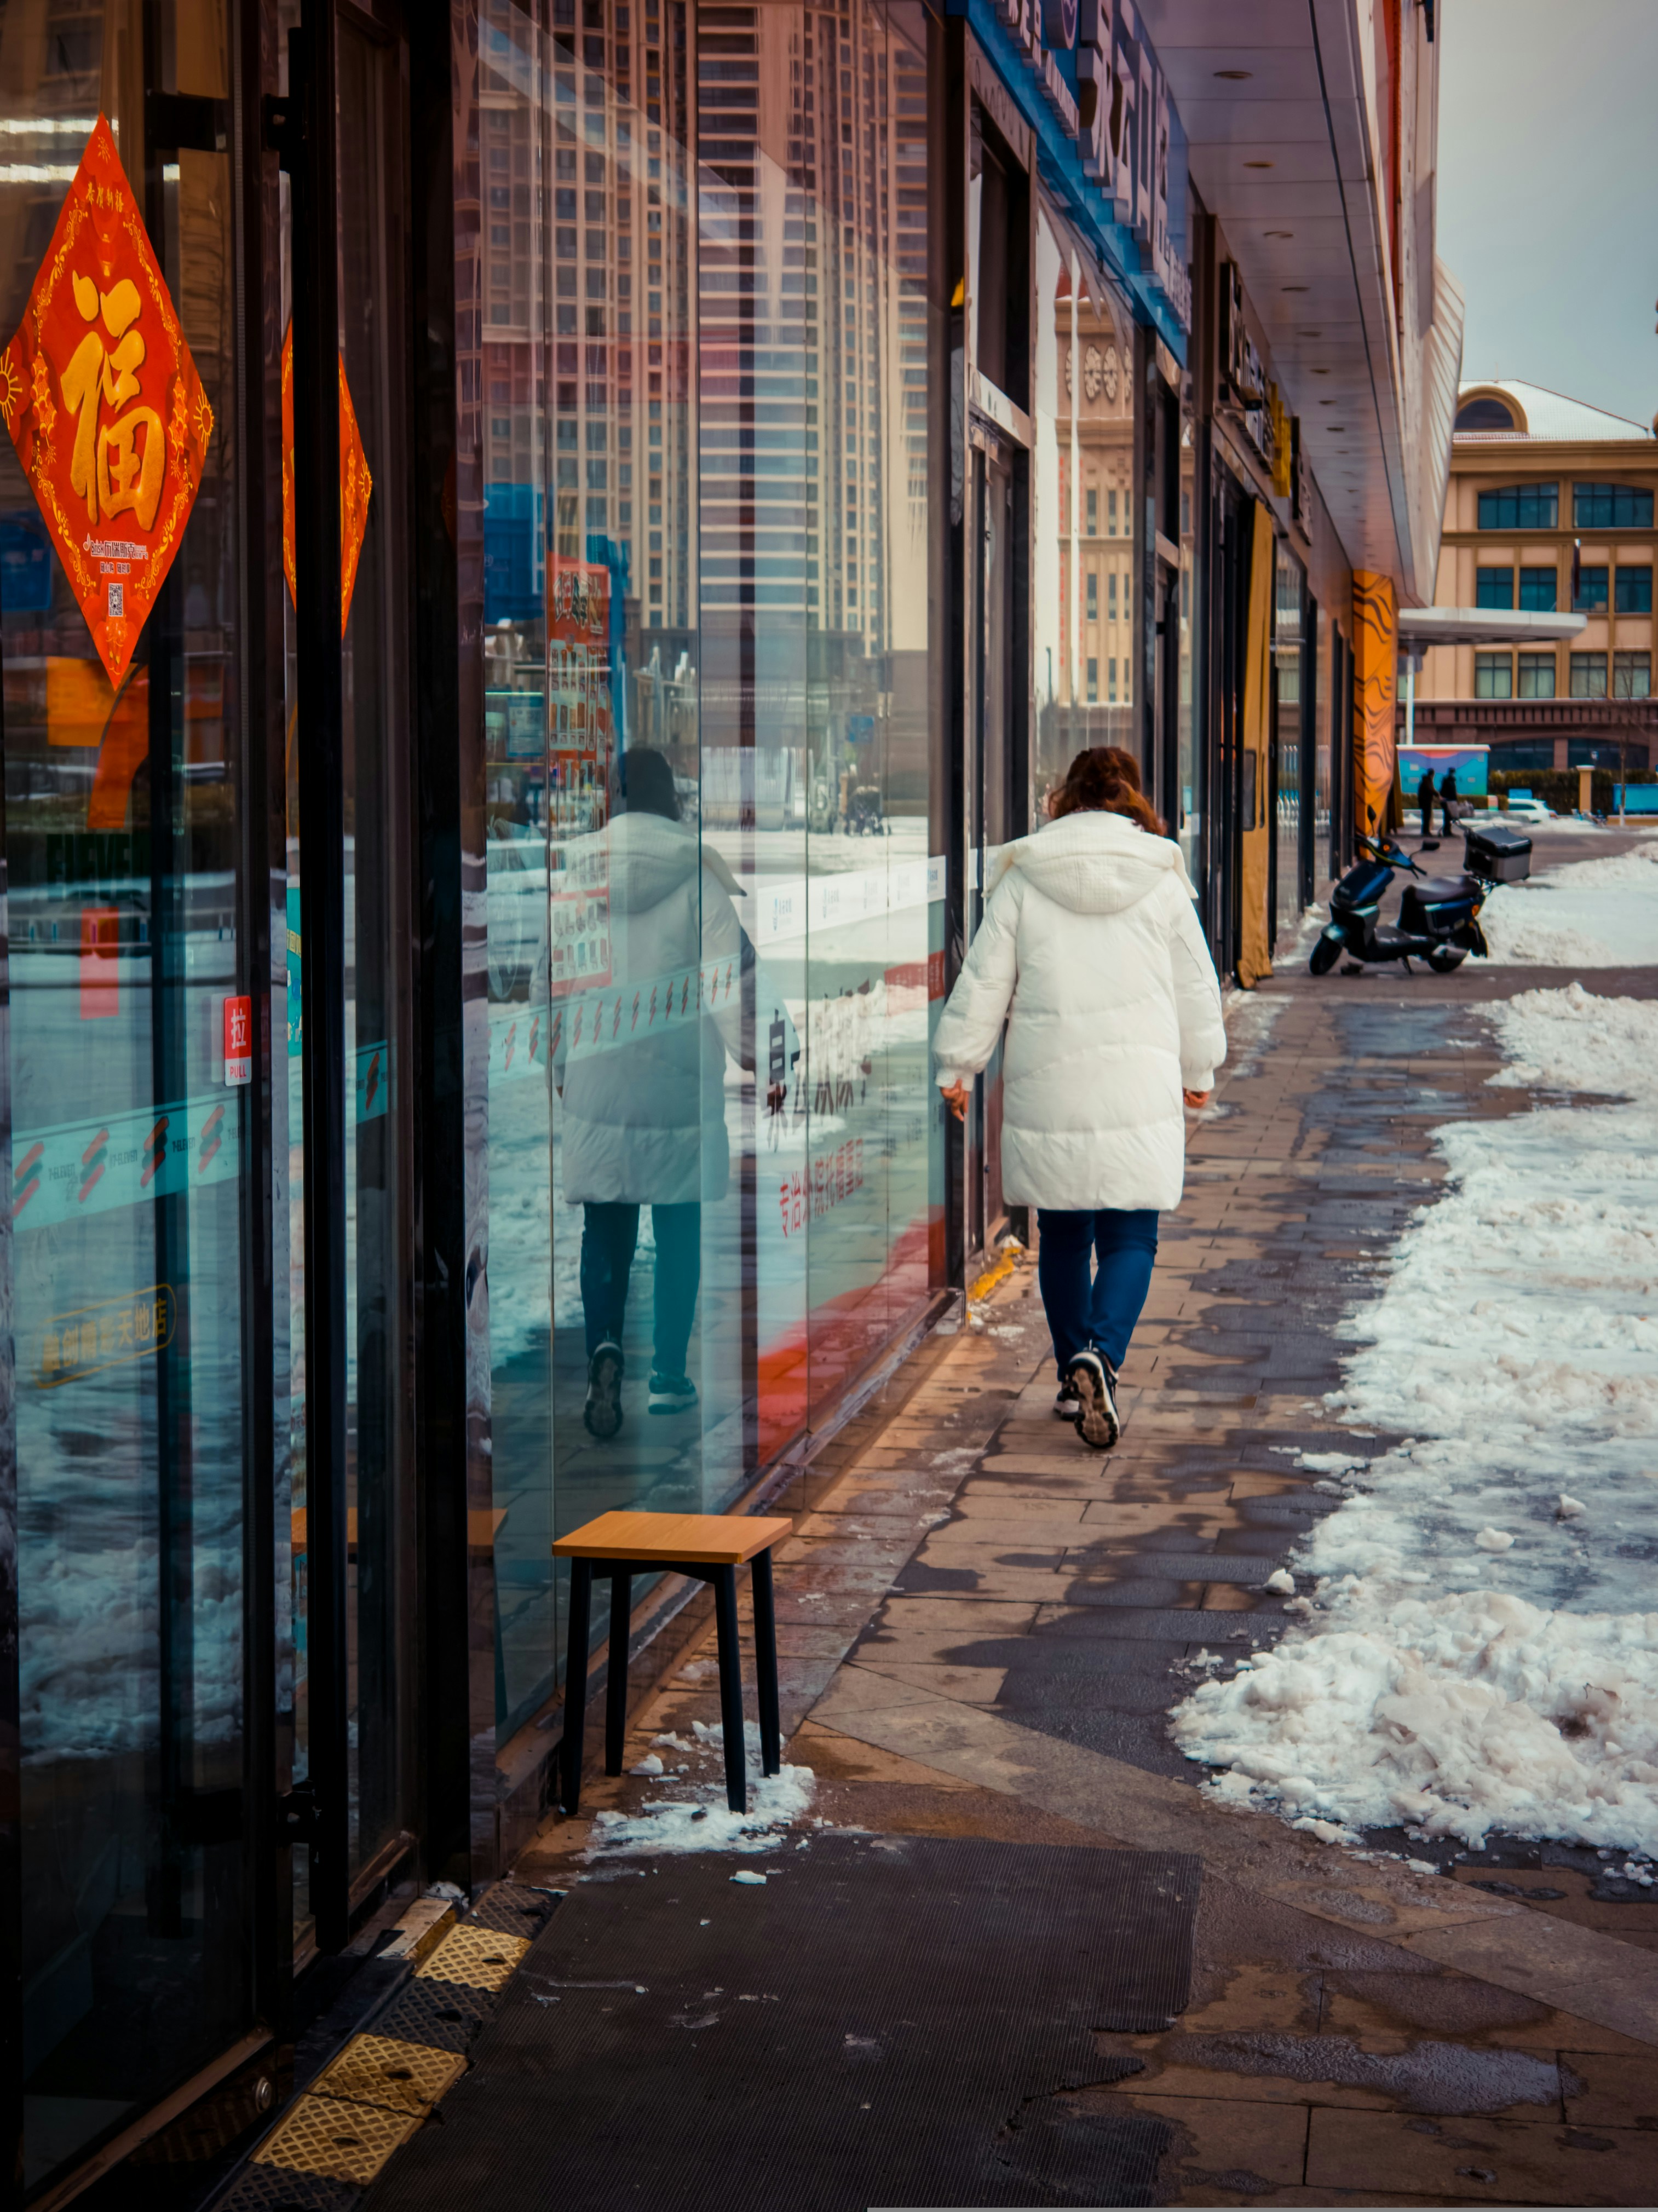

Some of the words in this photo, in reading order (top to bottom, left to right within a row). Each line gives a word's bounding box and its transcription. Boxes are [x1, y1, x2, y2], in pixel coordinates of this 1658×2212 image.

[61, 270, 166, 531] 福
[231, 1007, 246, 1050] 拉
[230, 1064, 246, 1078] PULL
